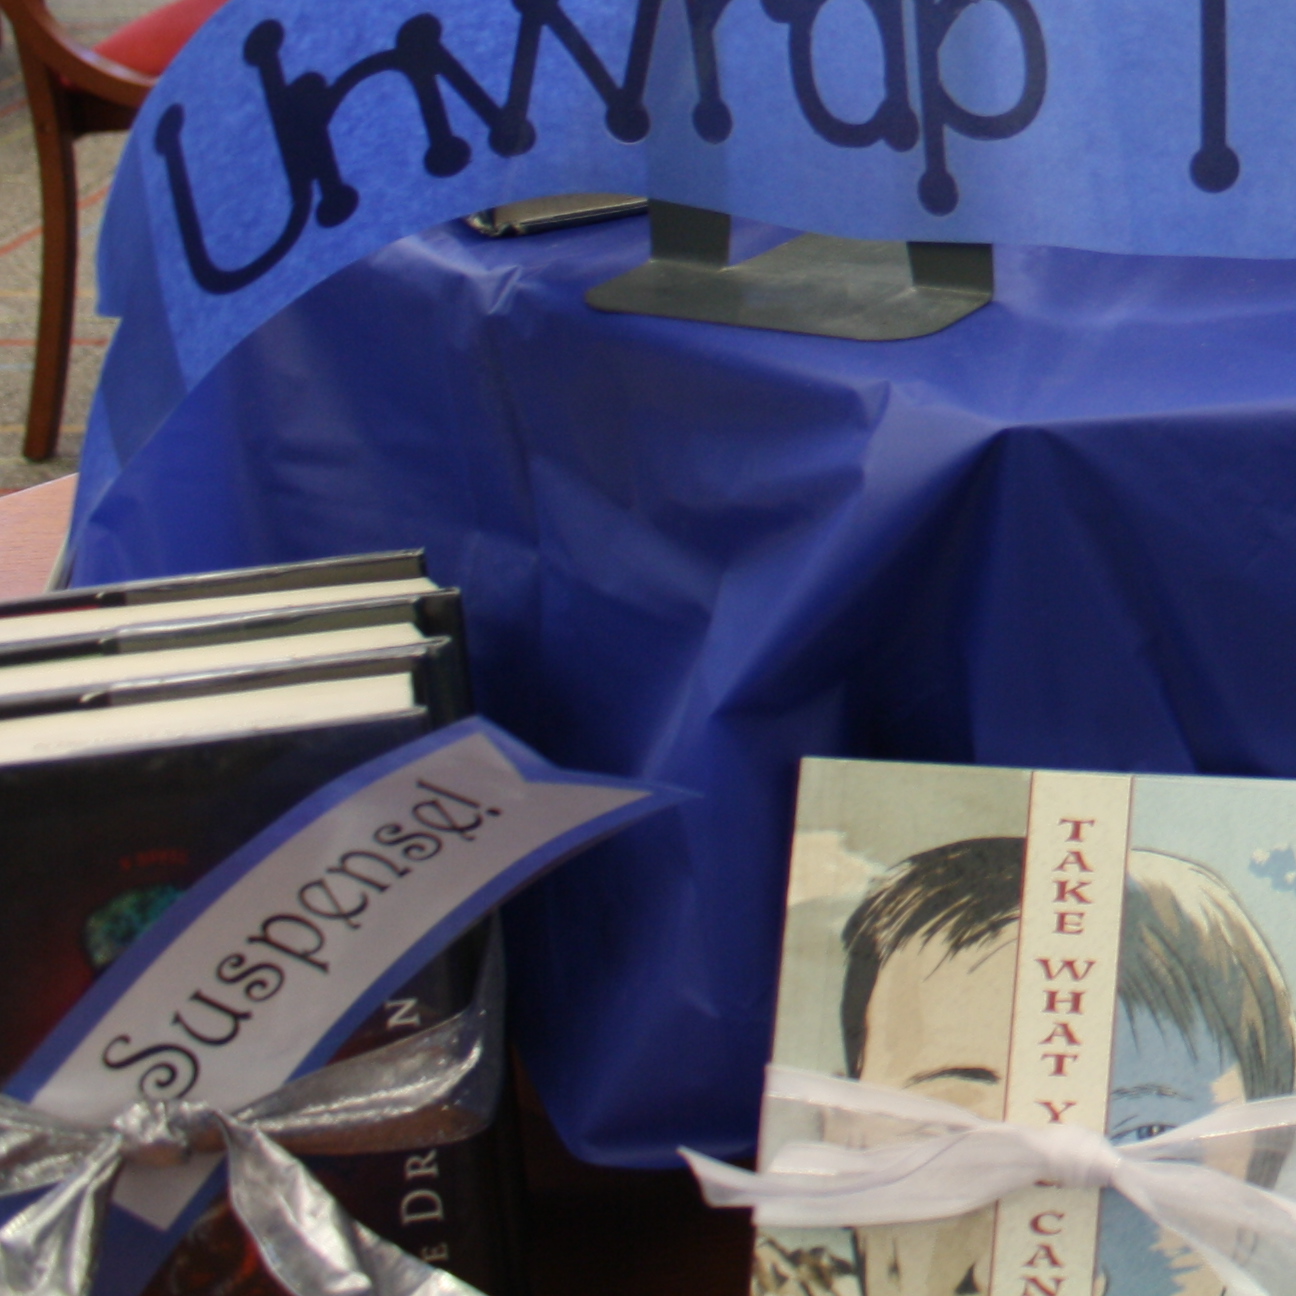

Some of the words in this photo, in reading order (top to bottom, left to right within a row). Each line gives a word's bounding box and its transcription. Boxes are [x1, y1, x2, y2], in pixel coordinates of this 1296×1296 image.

[1052, 818, 1096, 936] TAKE
[102, 777, 503, 1104] Suspense!
[1034, 957, 1097, 1077] WHAT
